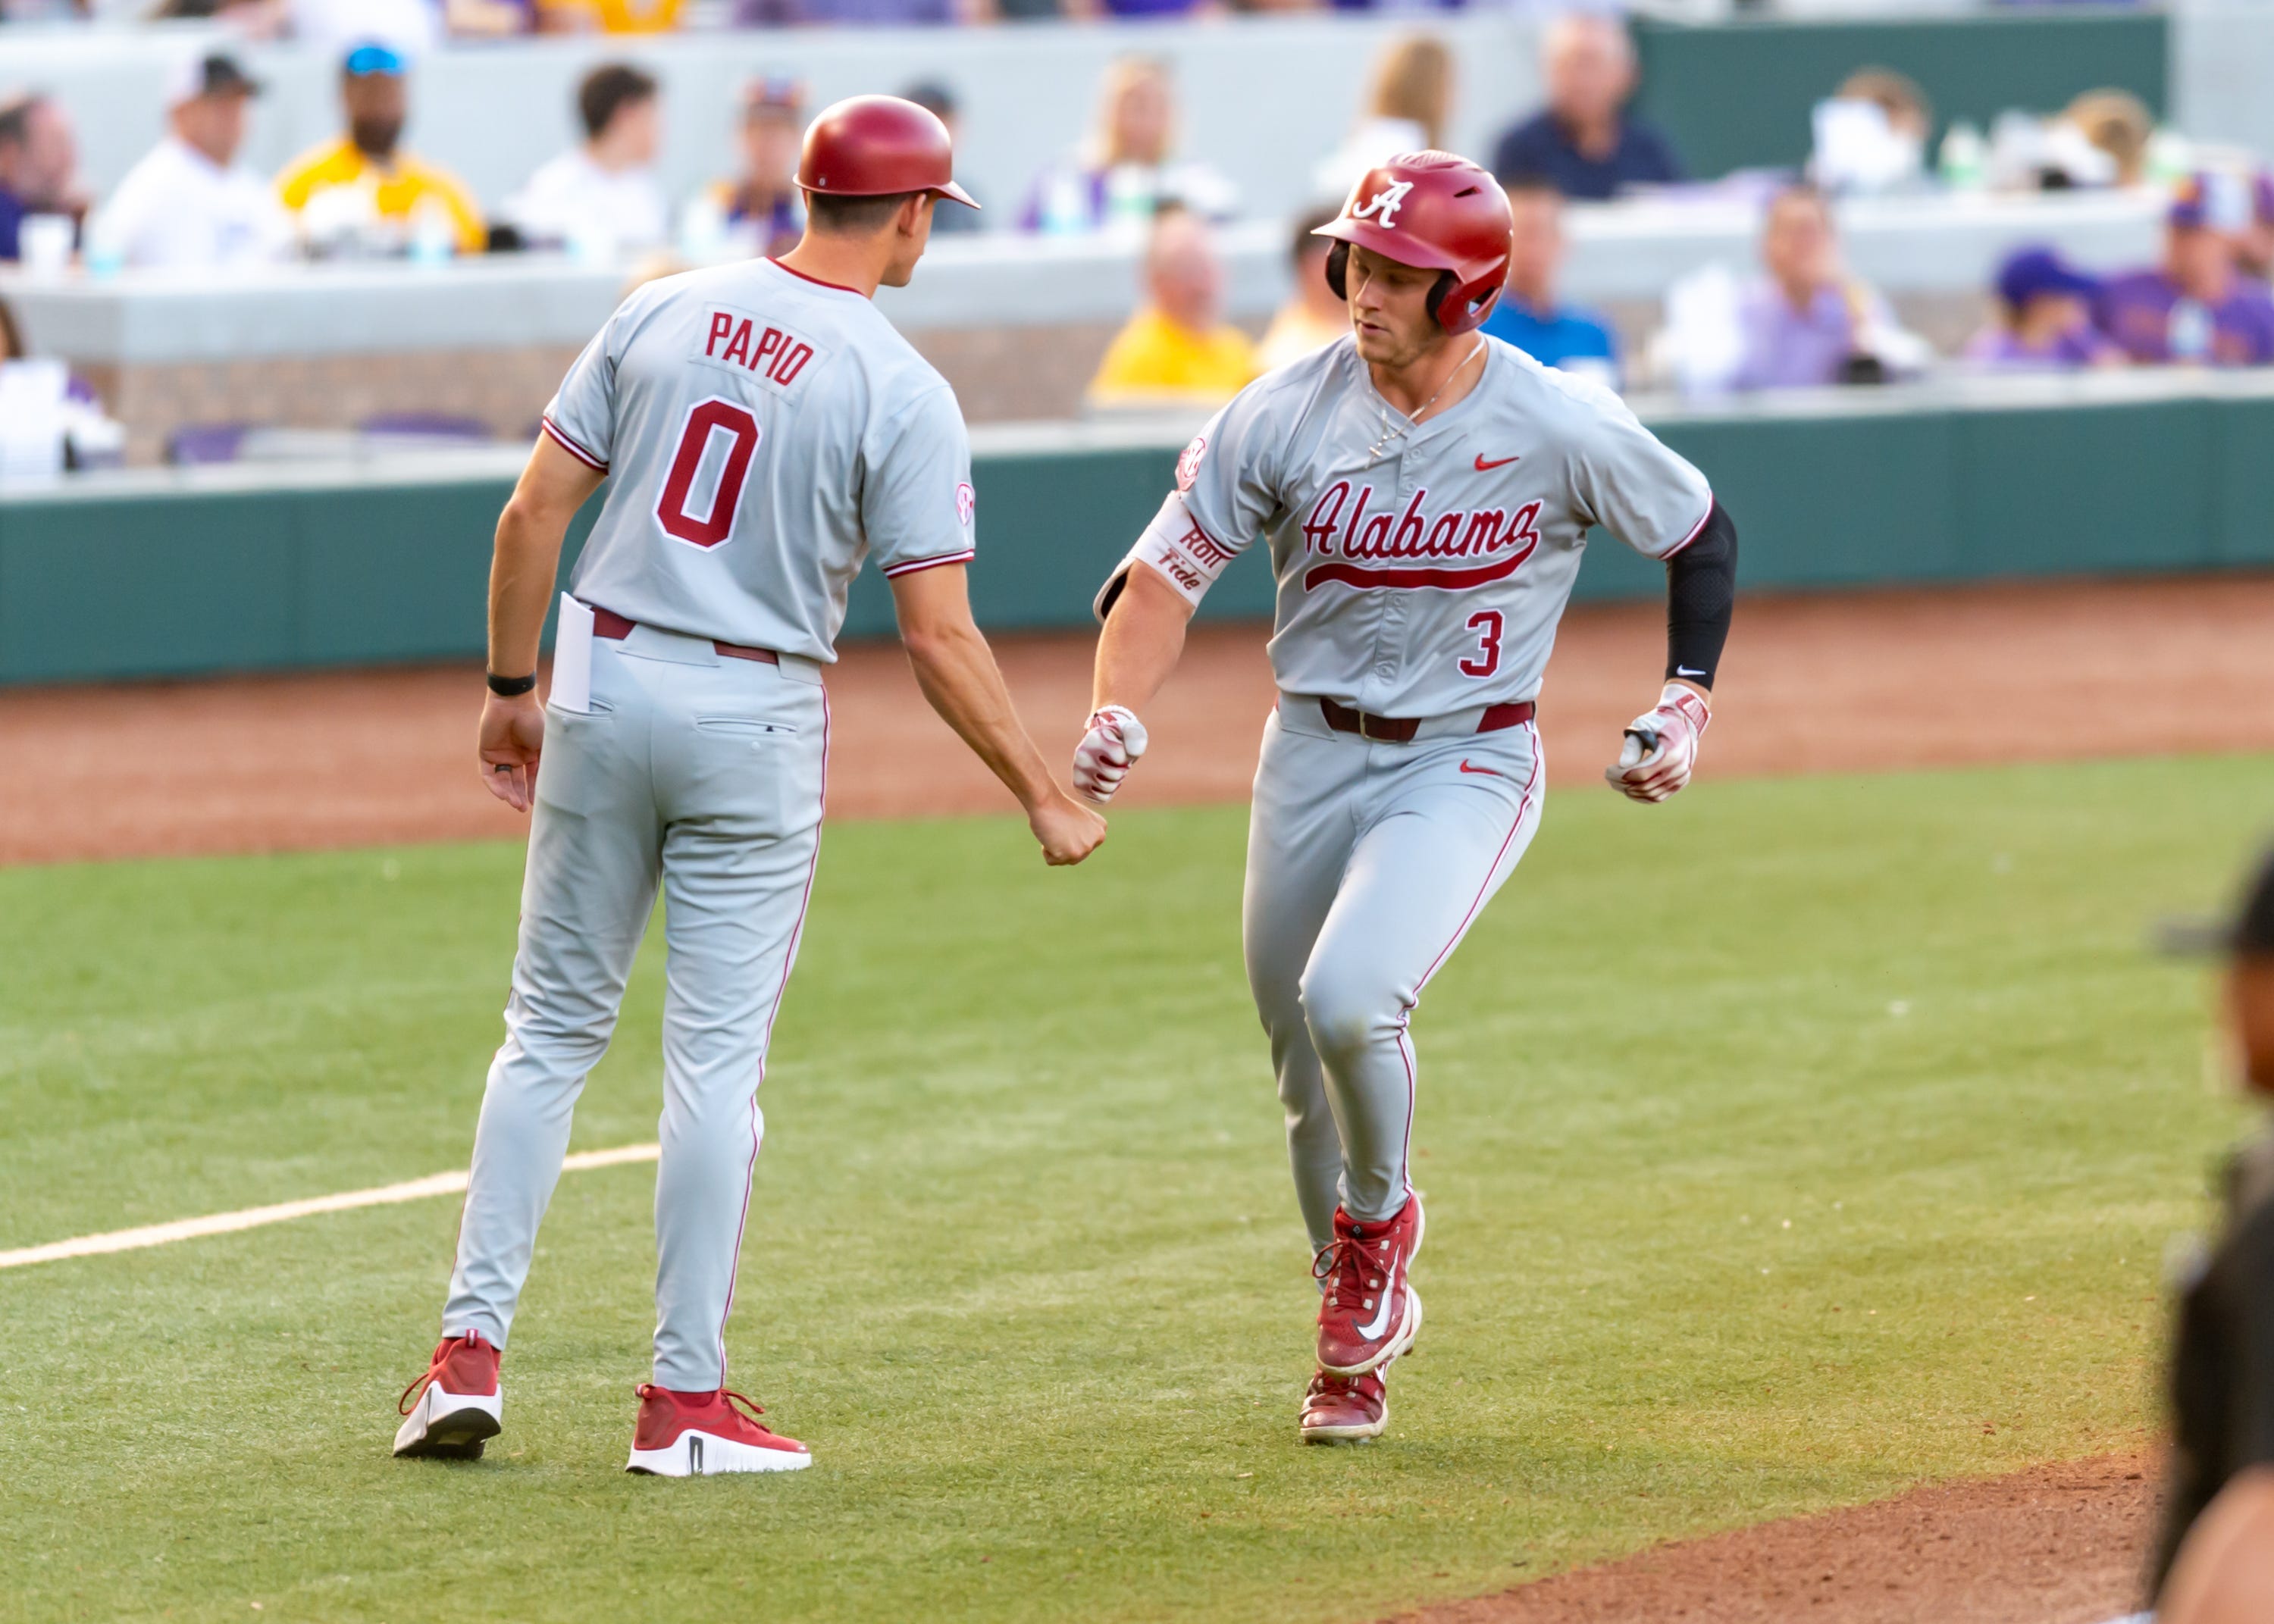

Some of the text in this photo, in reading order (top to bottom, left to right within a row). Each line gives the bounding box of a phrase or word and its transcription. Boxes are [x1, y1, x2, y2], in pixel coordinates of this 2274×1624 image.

[1352, 176, 1414, 229] A
[705, 311, 814, 386] PAPIO
[652, 394, 763, 552] 0
[1301, 480, 1544, 561] Alabama
[1157, 547, 1201, 591] Tide
[1457, 609, 1505, 680] 3
